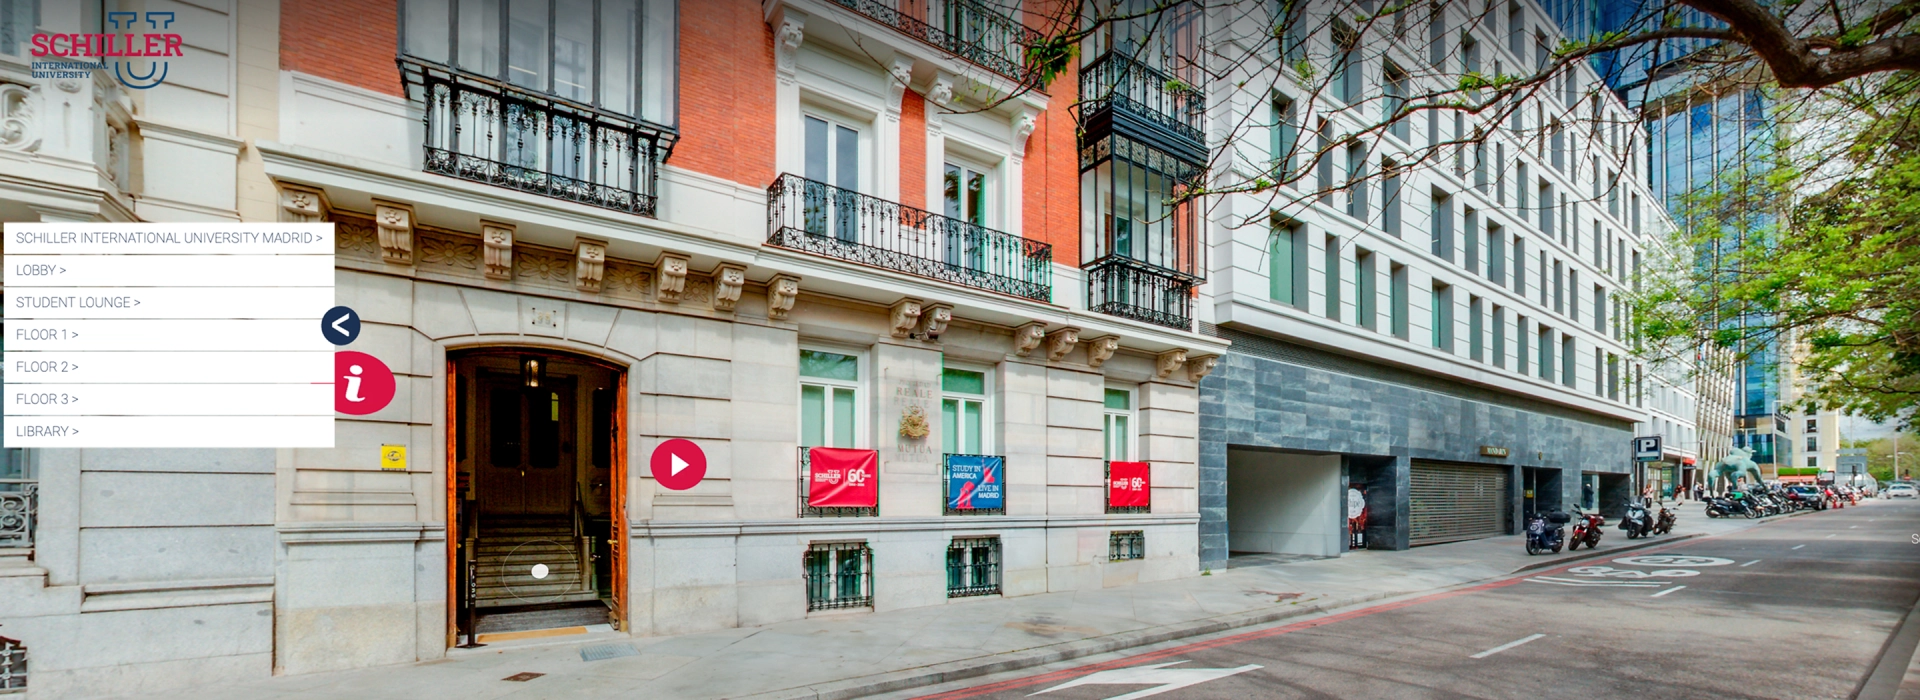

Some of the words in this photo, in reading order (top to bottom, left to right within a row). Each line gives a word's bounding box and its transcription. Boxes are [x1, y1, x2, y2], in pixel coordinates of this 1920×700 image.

[896, 386, 933, 399] REALE
[897, 443, 933, 454] MUTUA
[1640, 439, 1656, 452] P
[952, 464, 973, 472] STUDY
[952, 472, 977, 480] AMERICA
